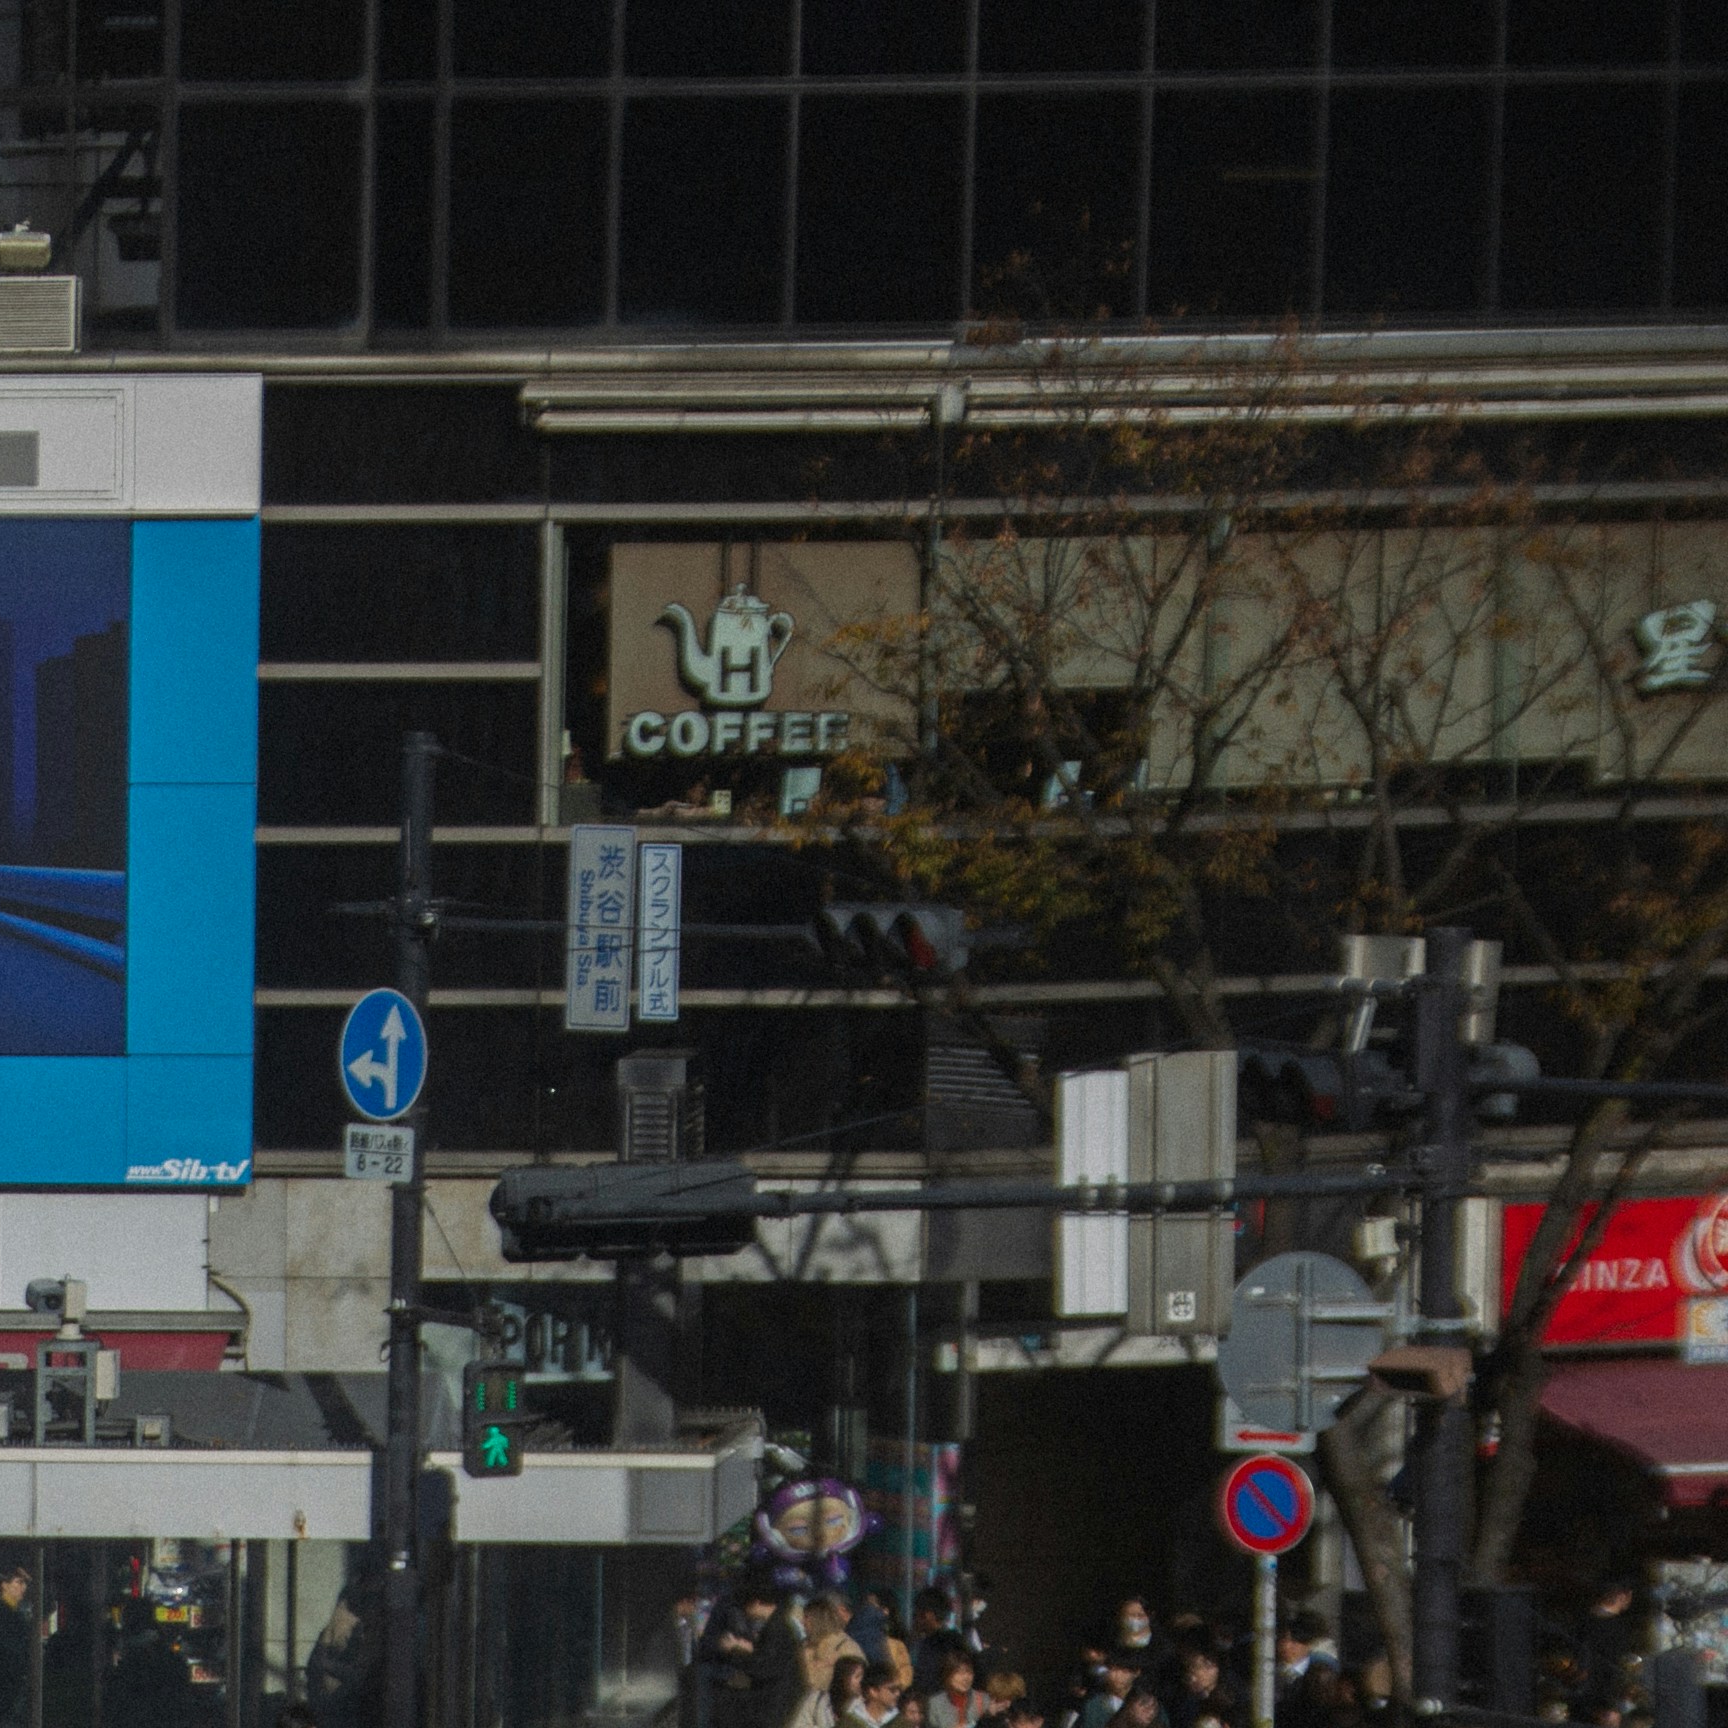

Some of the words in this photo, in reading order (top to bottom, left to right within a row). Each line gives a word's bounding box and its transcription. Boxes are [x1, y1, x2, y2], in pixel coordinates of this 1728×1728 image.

[626, 711, 851, 758] COFFEE
[578, 869, 596, 946] Shibuya
[594, 845, 627, 1013] 渋谷駅前
[648, 851, 672, 1013] スクランブル式
[576, 954, 592, 990] Sta.
[1556, 1257, 1670, 1291] INZA
